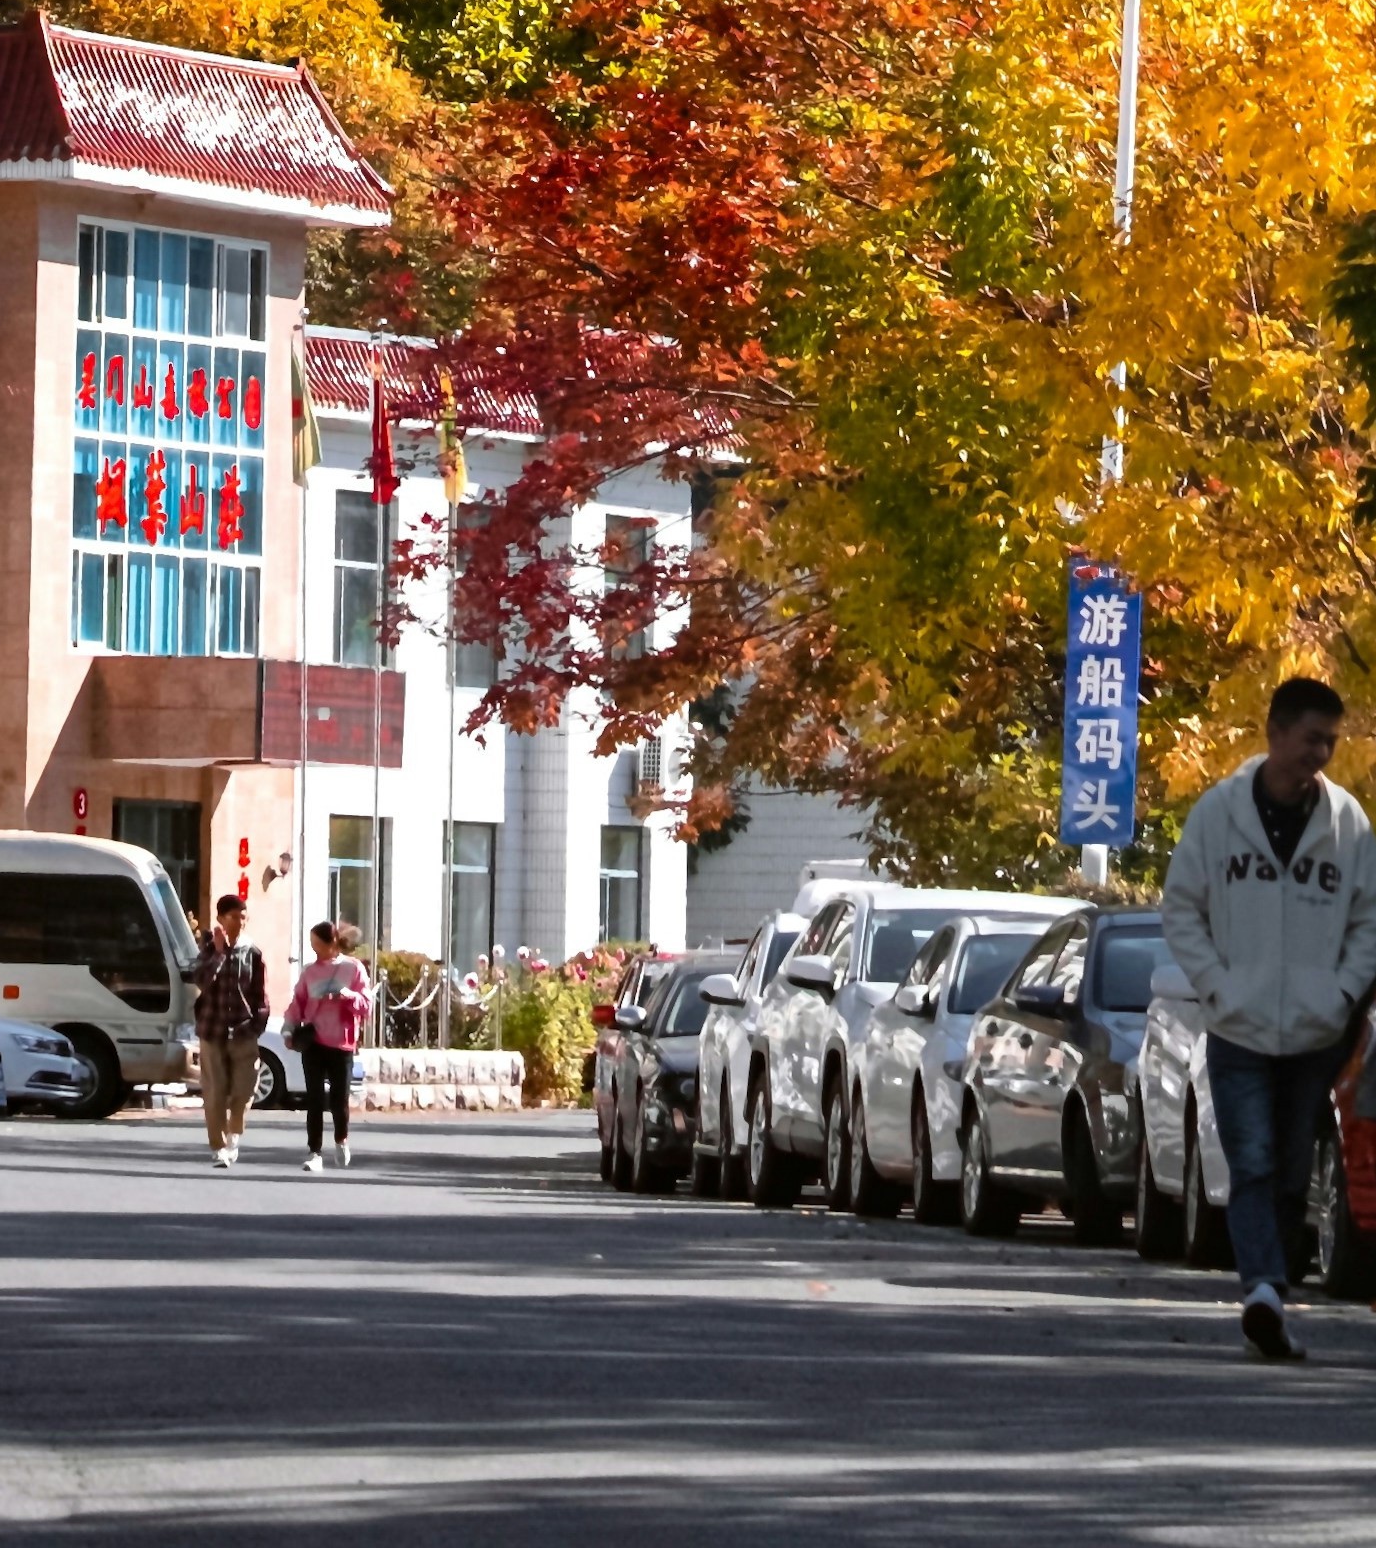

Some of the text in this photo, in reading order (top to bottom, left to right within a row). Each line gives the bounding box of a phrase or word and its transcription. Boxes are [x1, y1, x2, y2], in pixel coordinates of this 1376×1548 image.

[1073, 594, 1128, 830] 游船码头
[78, 793, 87, 815] 3
[1226, 853, 1342, 894] wave
